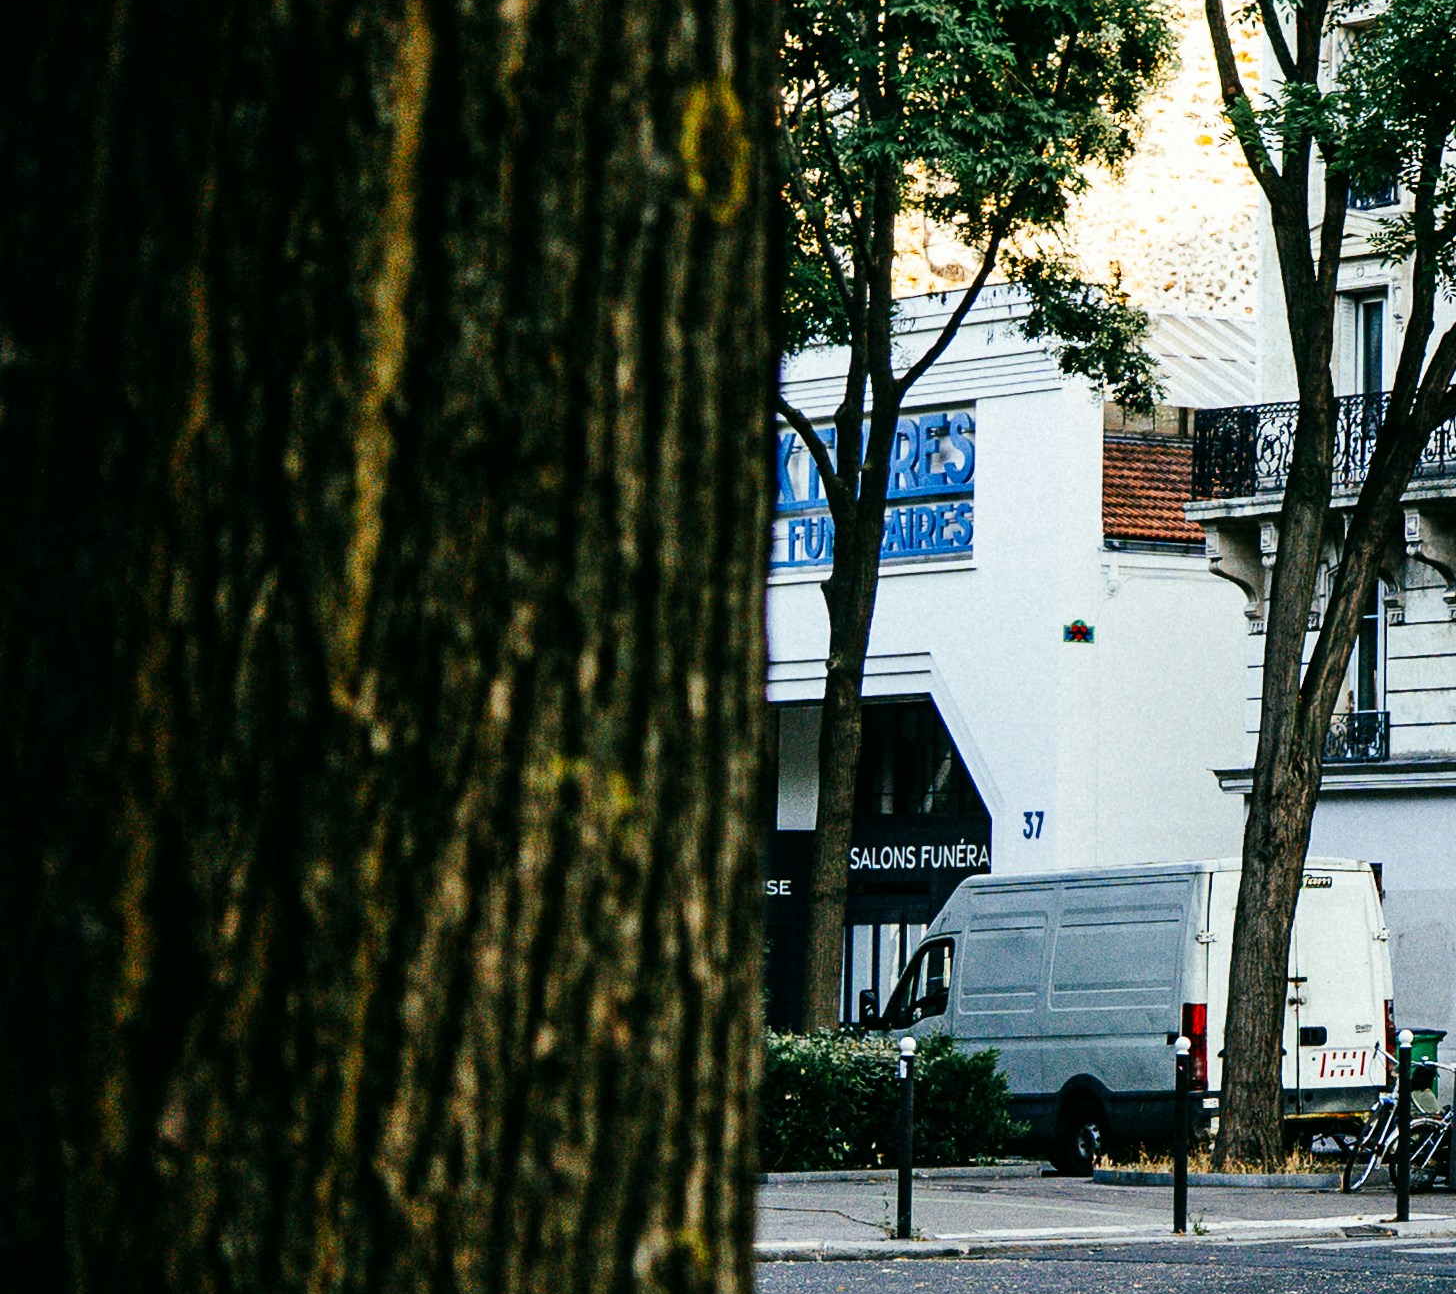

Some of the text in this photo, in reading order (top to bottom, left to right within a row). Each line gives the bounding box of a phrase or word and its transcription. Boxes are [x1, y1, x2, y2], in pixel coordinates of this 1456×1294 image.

[789, 503, 974, 562] FUNAIRES
[1023, 810, 1044, 839] 37
[850, 838, 991, 870] SALONS FUNÉRA
[764, 879, 792, 896] SE
